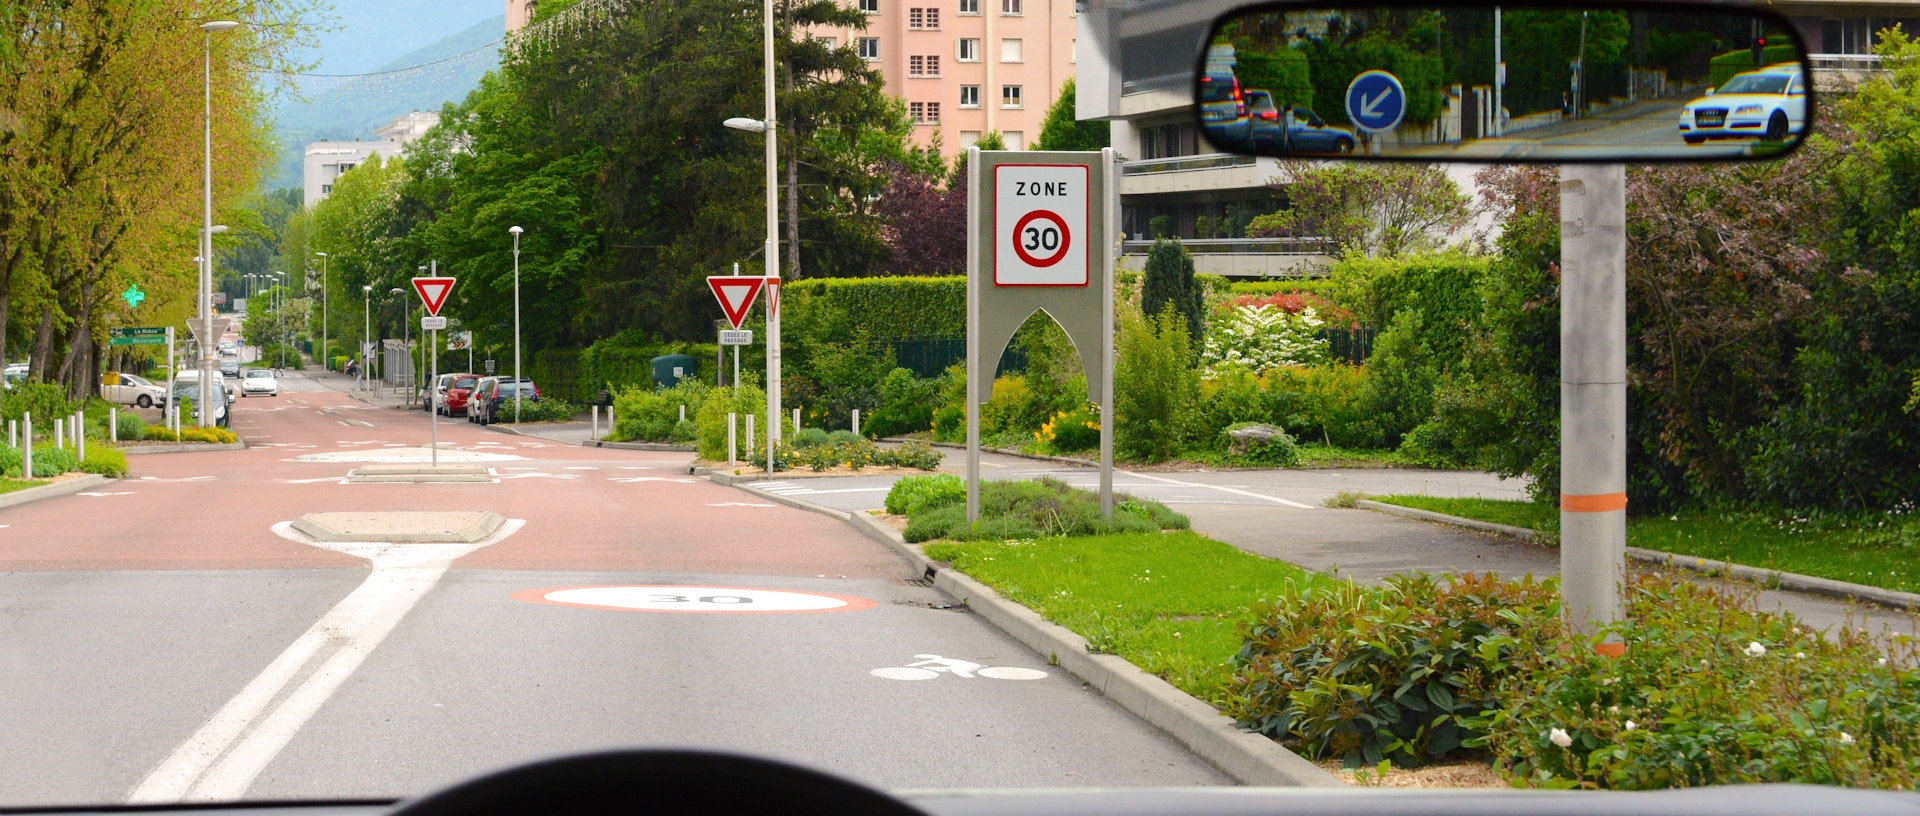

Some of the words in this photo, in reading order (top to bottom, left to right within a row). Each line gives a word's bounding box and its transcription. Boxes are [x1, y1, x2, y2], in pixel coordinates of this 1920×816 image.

[1016, 181, 1067, 196] ZONE
[1024, 227, 1059, 251] 30
[648, 594, 753, 604] 30
